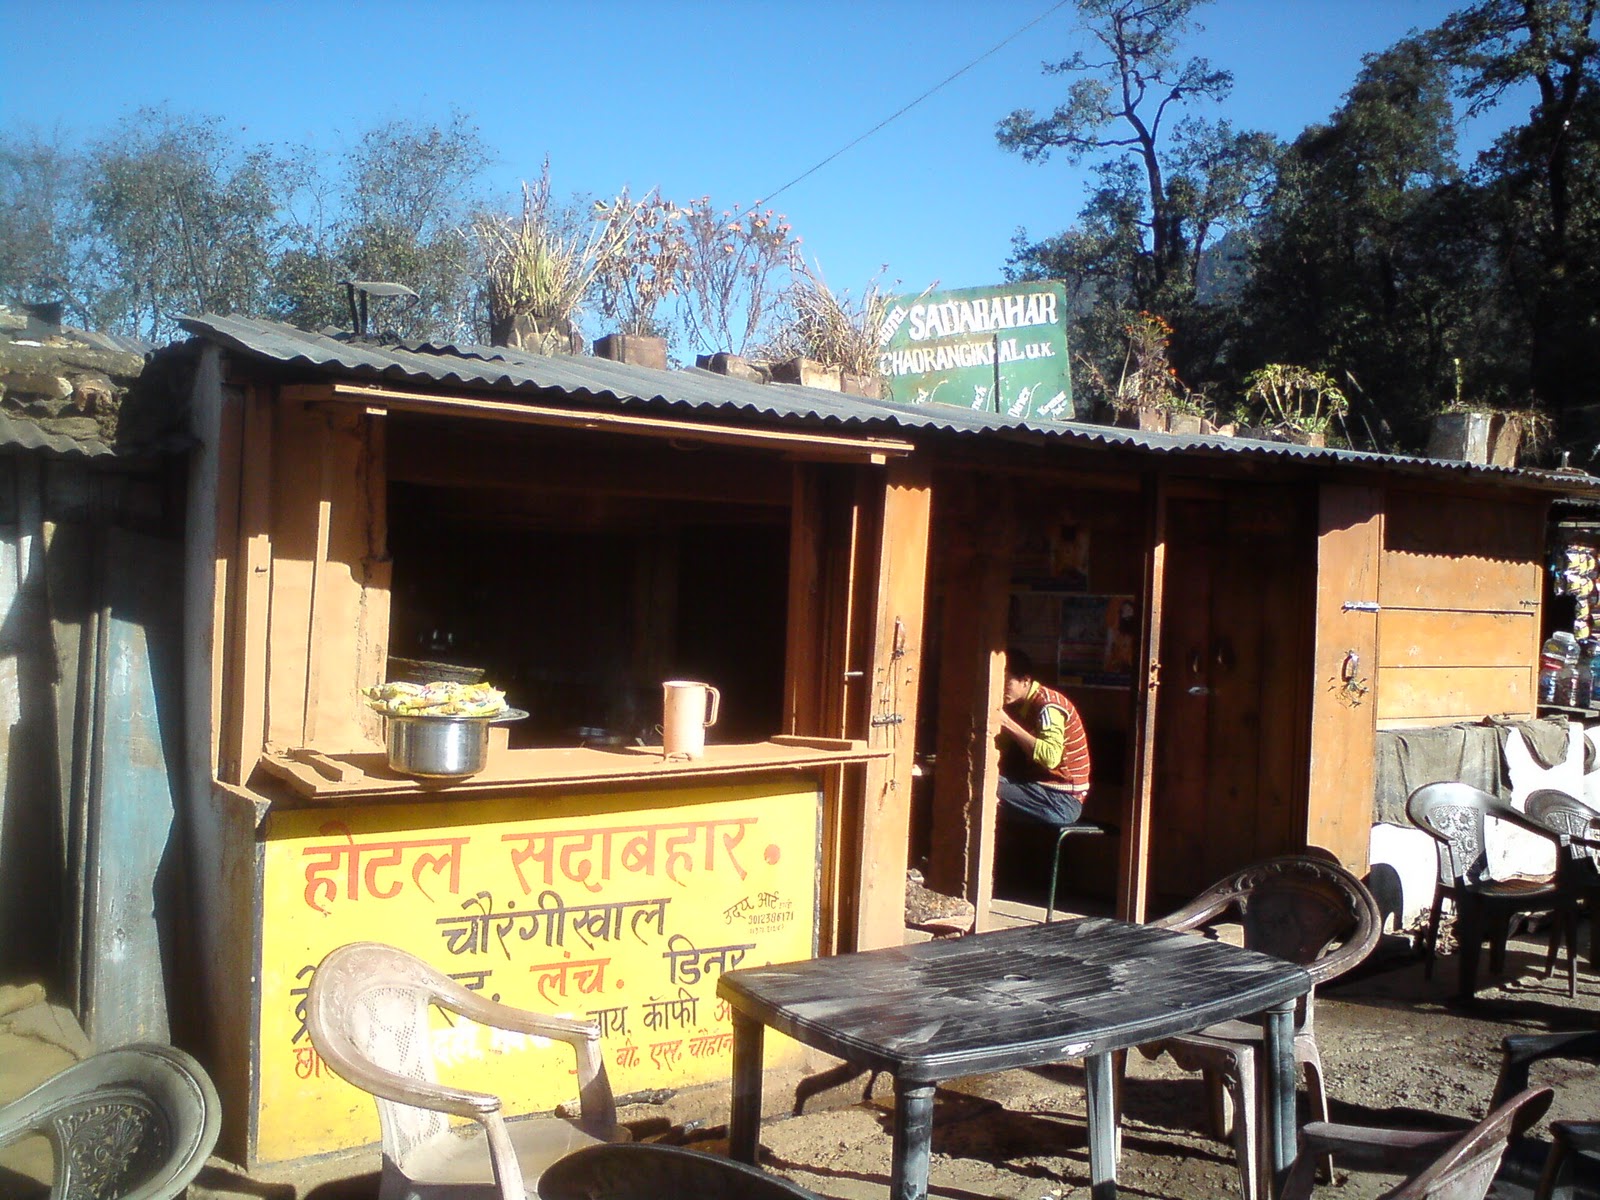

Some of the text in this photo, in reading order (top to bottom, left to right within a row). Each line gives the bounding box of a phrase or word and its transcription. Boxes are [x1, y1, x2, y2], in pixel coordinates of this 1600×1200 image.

[909, 292, 1059, 341] SADABAHAR
[302, 820, 471, 917] होटल
[436, 890, 672, 962] चौरंगीखाल
[642, 987, 699, 1032] कॉफी
